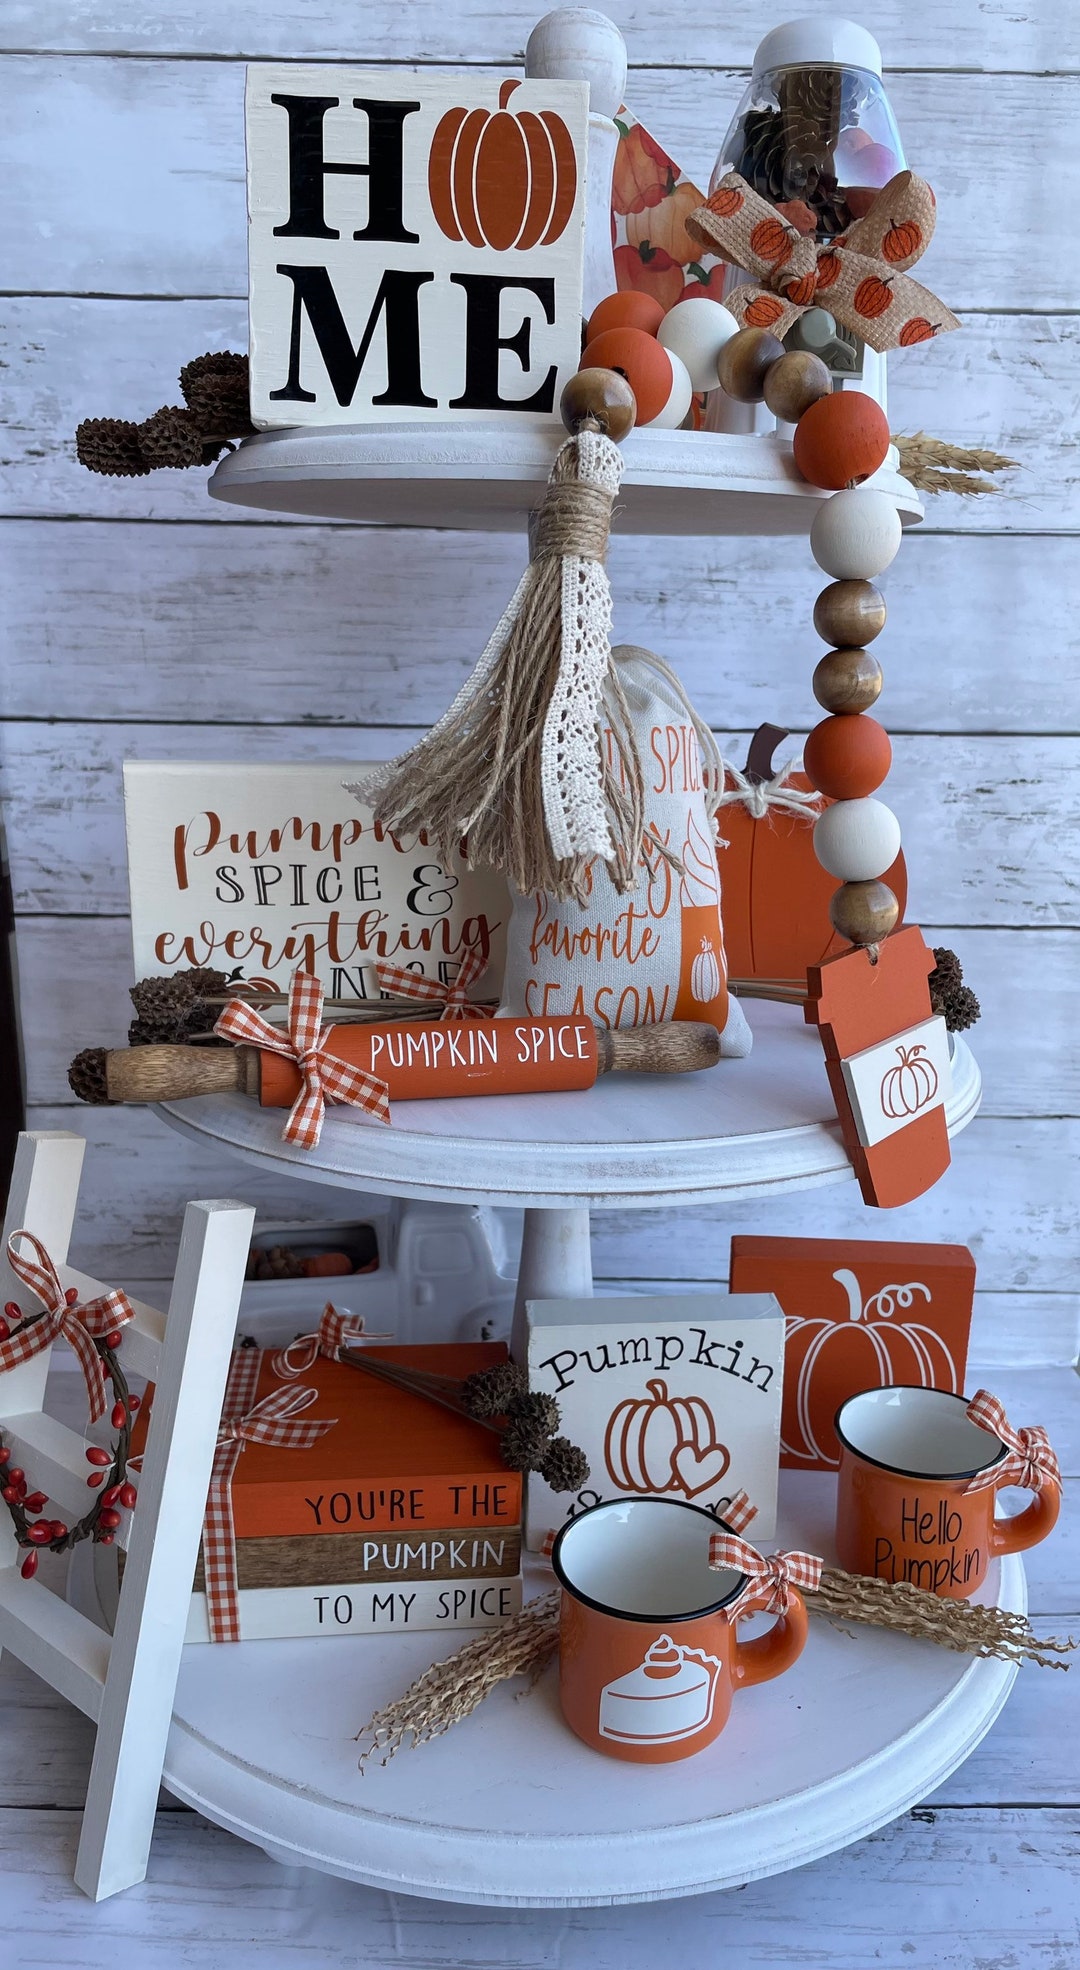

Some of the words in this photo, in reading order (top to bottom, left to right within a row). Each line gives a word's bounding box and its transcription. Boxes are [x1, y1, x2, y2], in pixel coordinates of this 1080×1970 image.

[269, 264, 559, 412] ME
[215, 864, 381, 907] SPICE
[406, 865, 459, 916] &
[155, 909, 502, 973] everything
[529, 892, 661, 965] favorite
[371, 1029, 499, 1071] PUMPKIN
[515, 1025, 591, 1064] SPICE
[539, 1328, 775, 1394] Pumpkin
[305, 1488, 425, 1525] YOU'RE
[448, 1485, 508, 1518] THE
[901, 1497, 963, 1545] Hello
[362, 1540, 505, 1571] PUMPKIN
[874, 1537, 980, 1593] Pumpkin
[314, 1595, 353, 1624] TO
[372, 1593, 417, 1623] MY
[436, 1587, 512, 1619] SPICE
